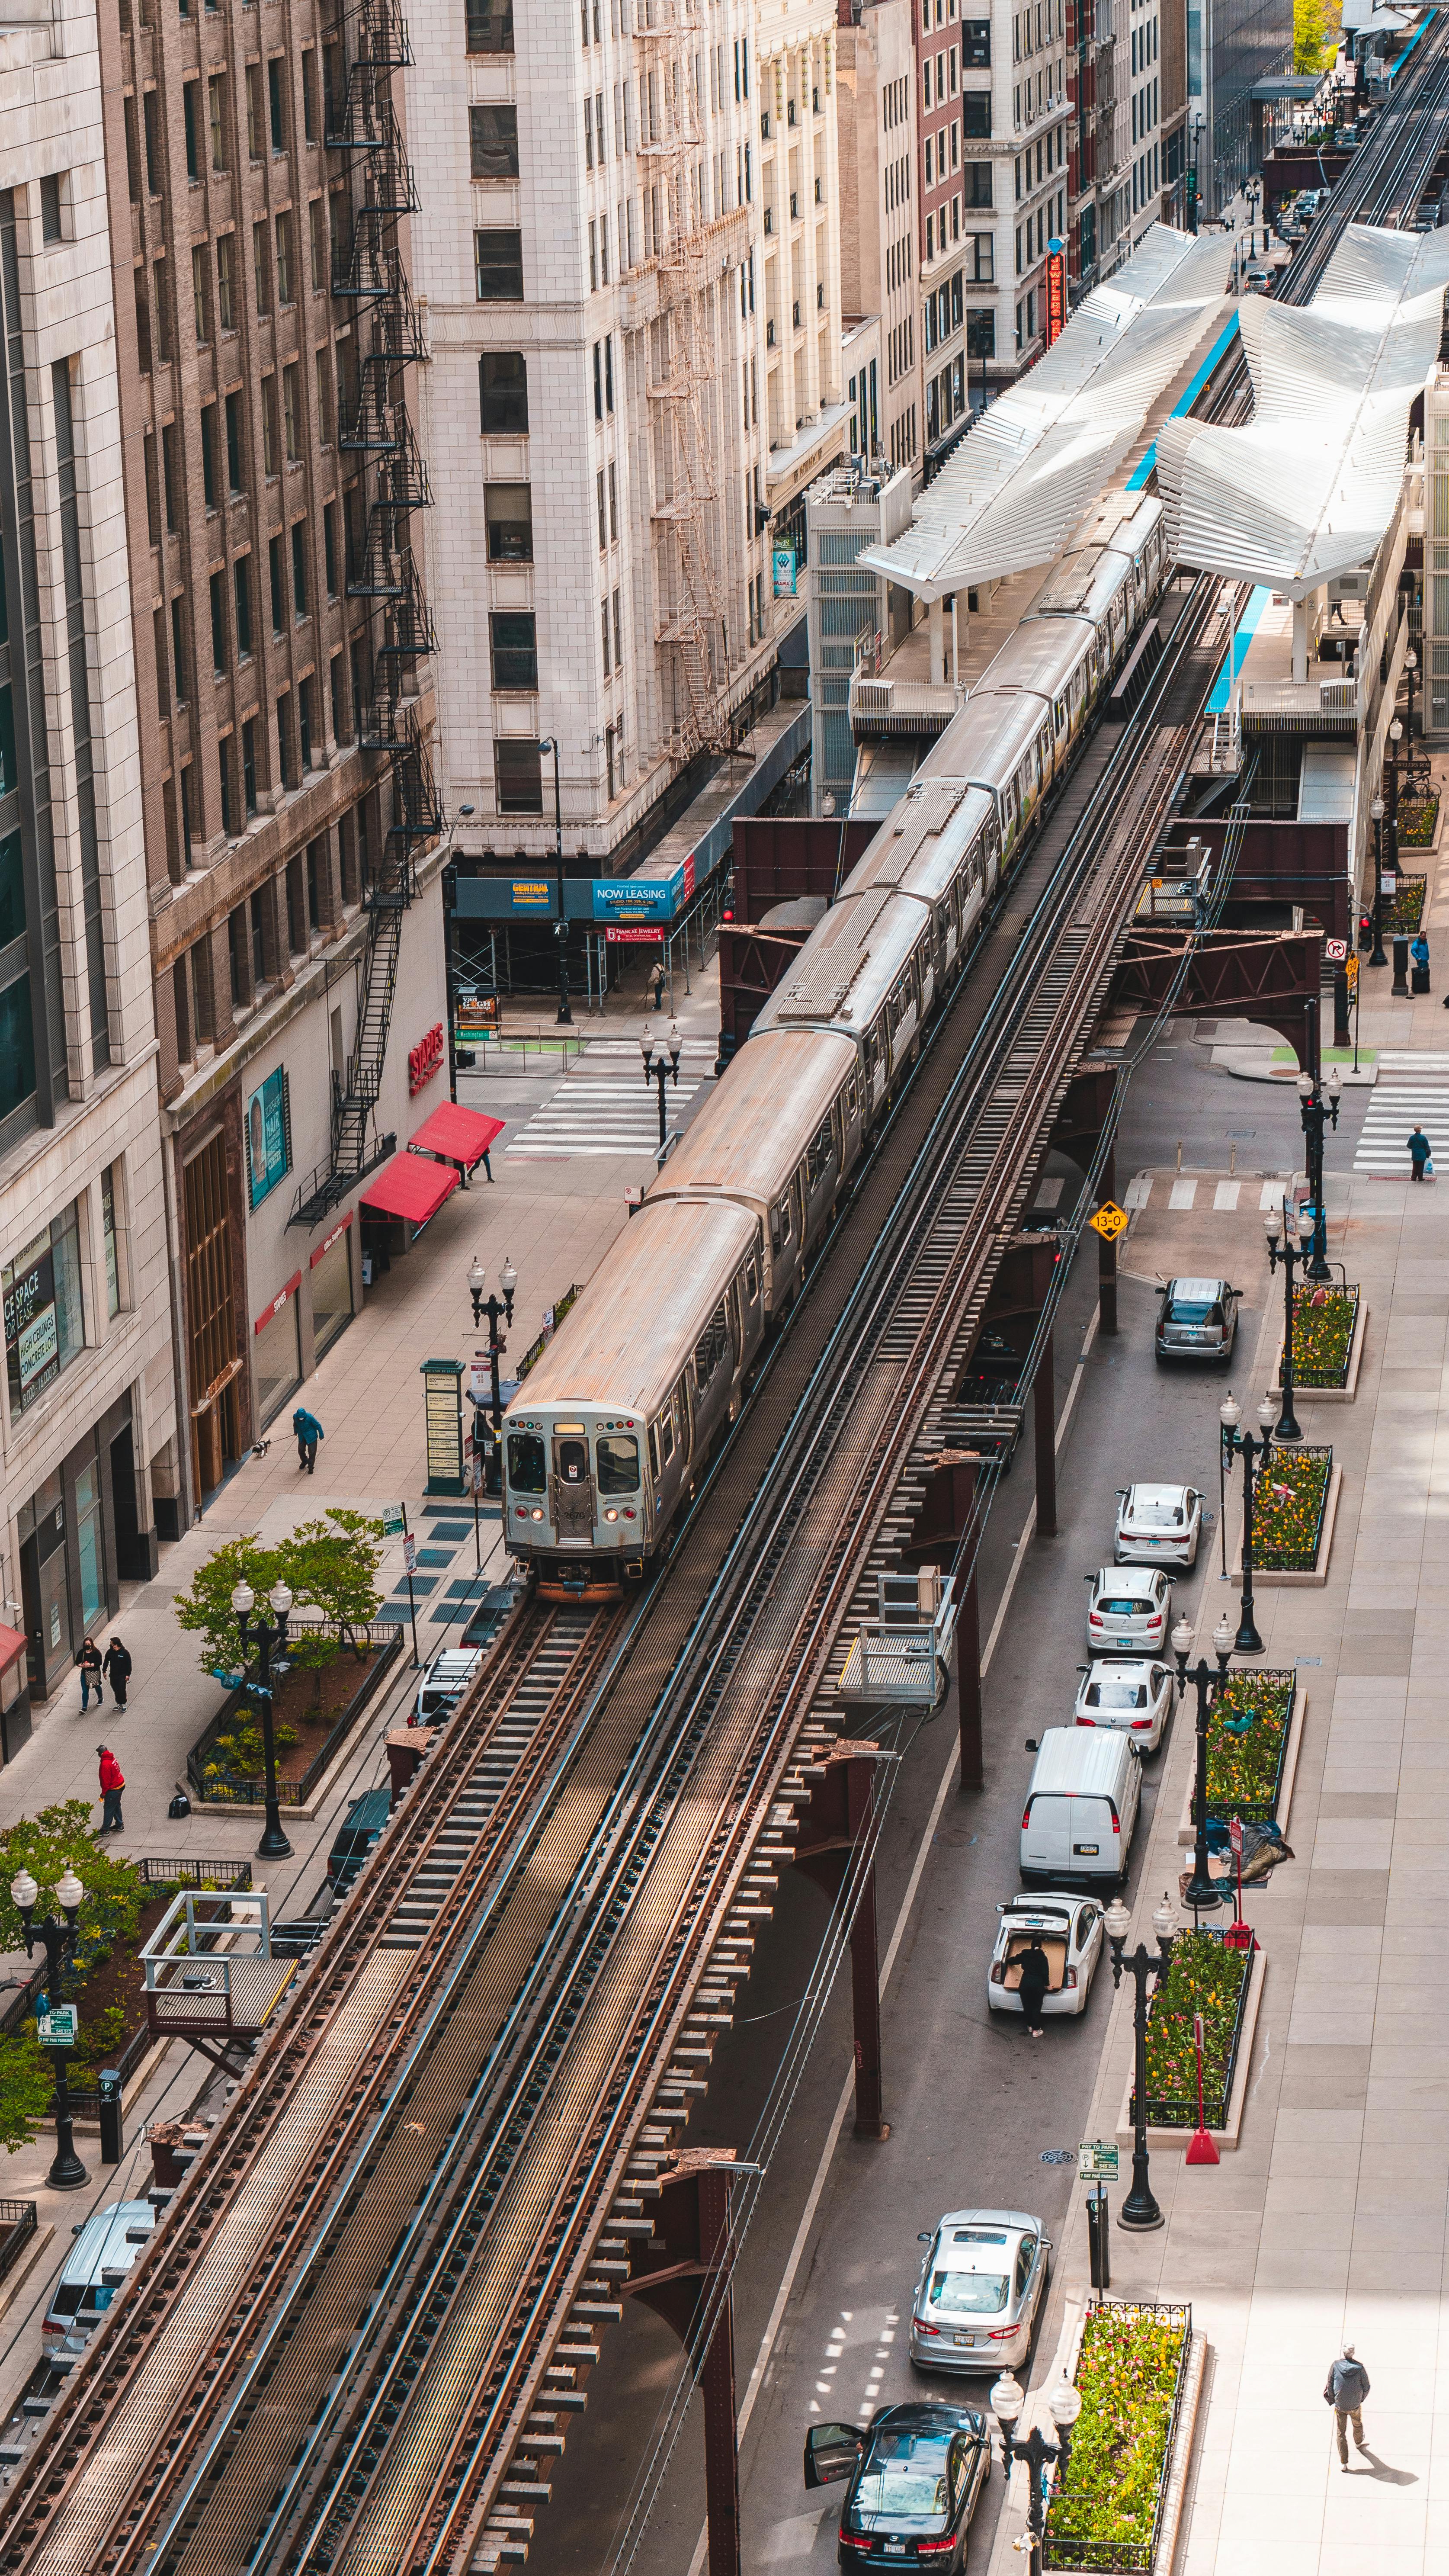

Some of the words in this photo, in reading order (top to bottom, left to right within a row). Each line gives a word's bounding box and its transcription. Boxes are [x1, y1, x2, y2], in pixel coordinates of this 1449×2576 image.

[1049, 256, 1062, 317] JEWELERS
[513, 883, 548, 892] CENTRAL
[597, 890, 623, 898] NOW
[626, 890, 666, 899] LEASING
[410, 1021, 444, 1080] STAPLES
[266, 1111, 280, 1140] HAIR
[16, 1270, 38, 1310] SPACE
[273, 1291, 286, 1313] STAPLES
[17, 1299, 33, 1329] LEASE
[20, 1337, 32, 1359] HIGH
[33, 1314, 54, 1345] CEILINGS
[21, 1345, 45, 1378] CONCRETE
[45, 1331, 56, 1352] LOFT
